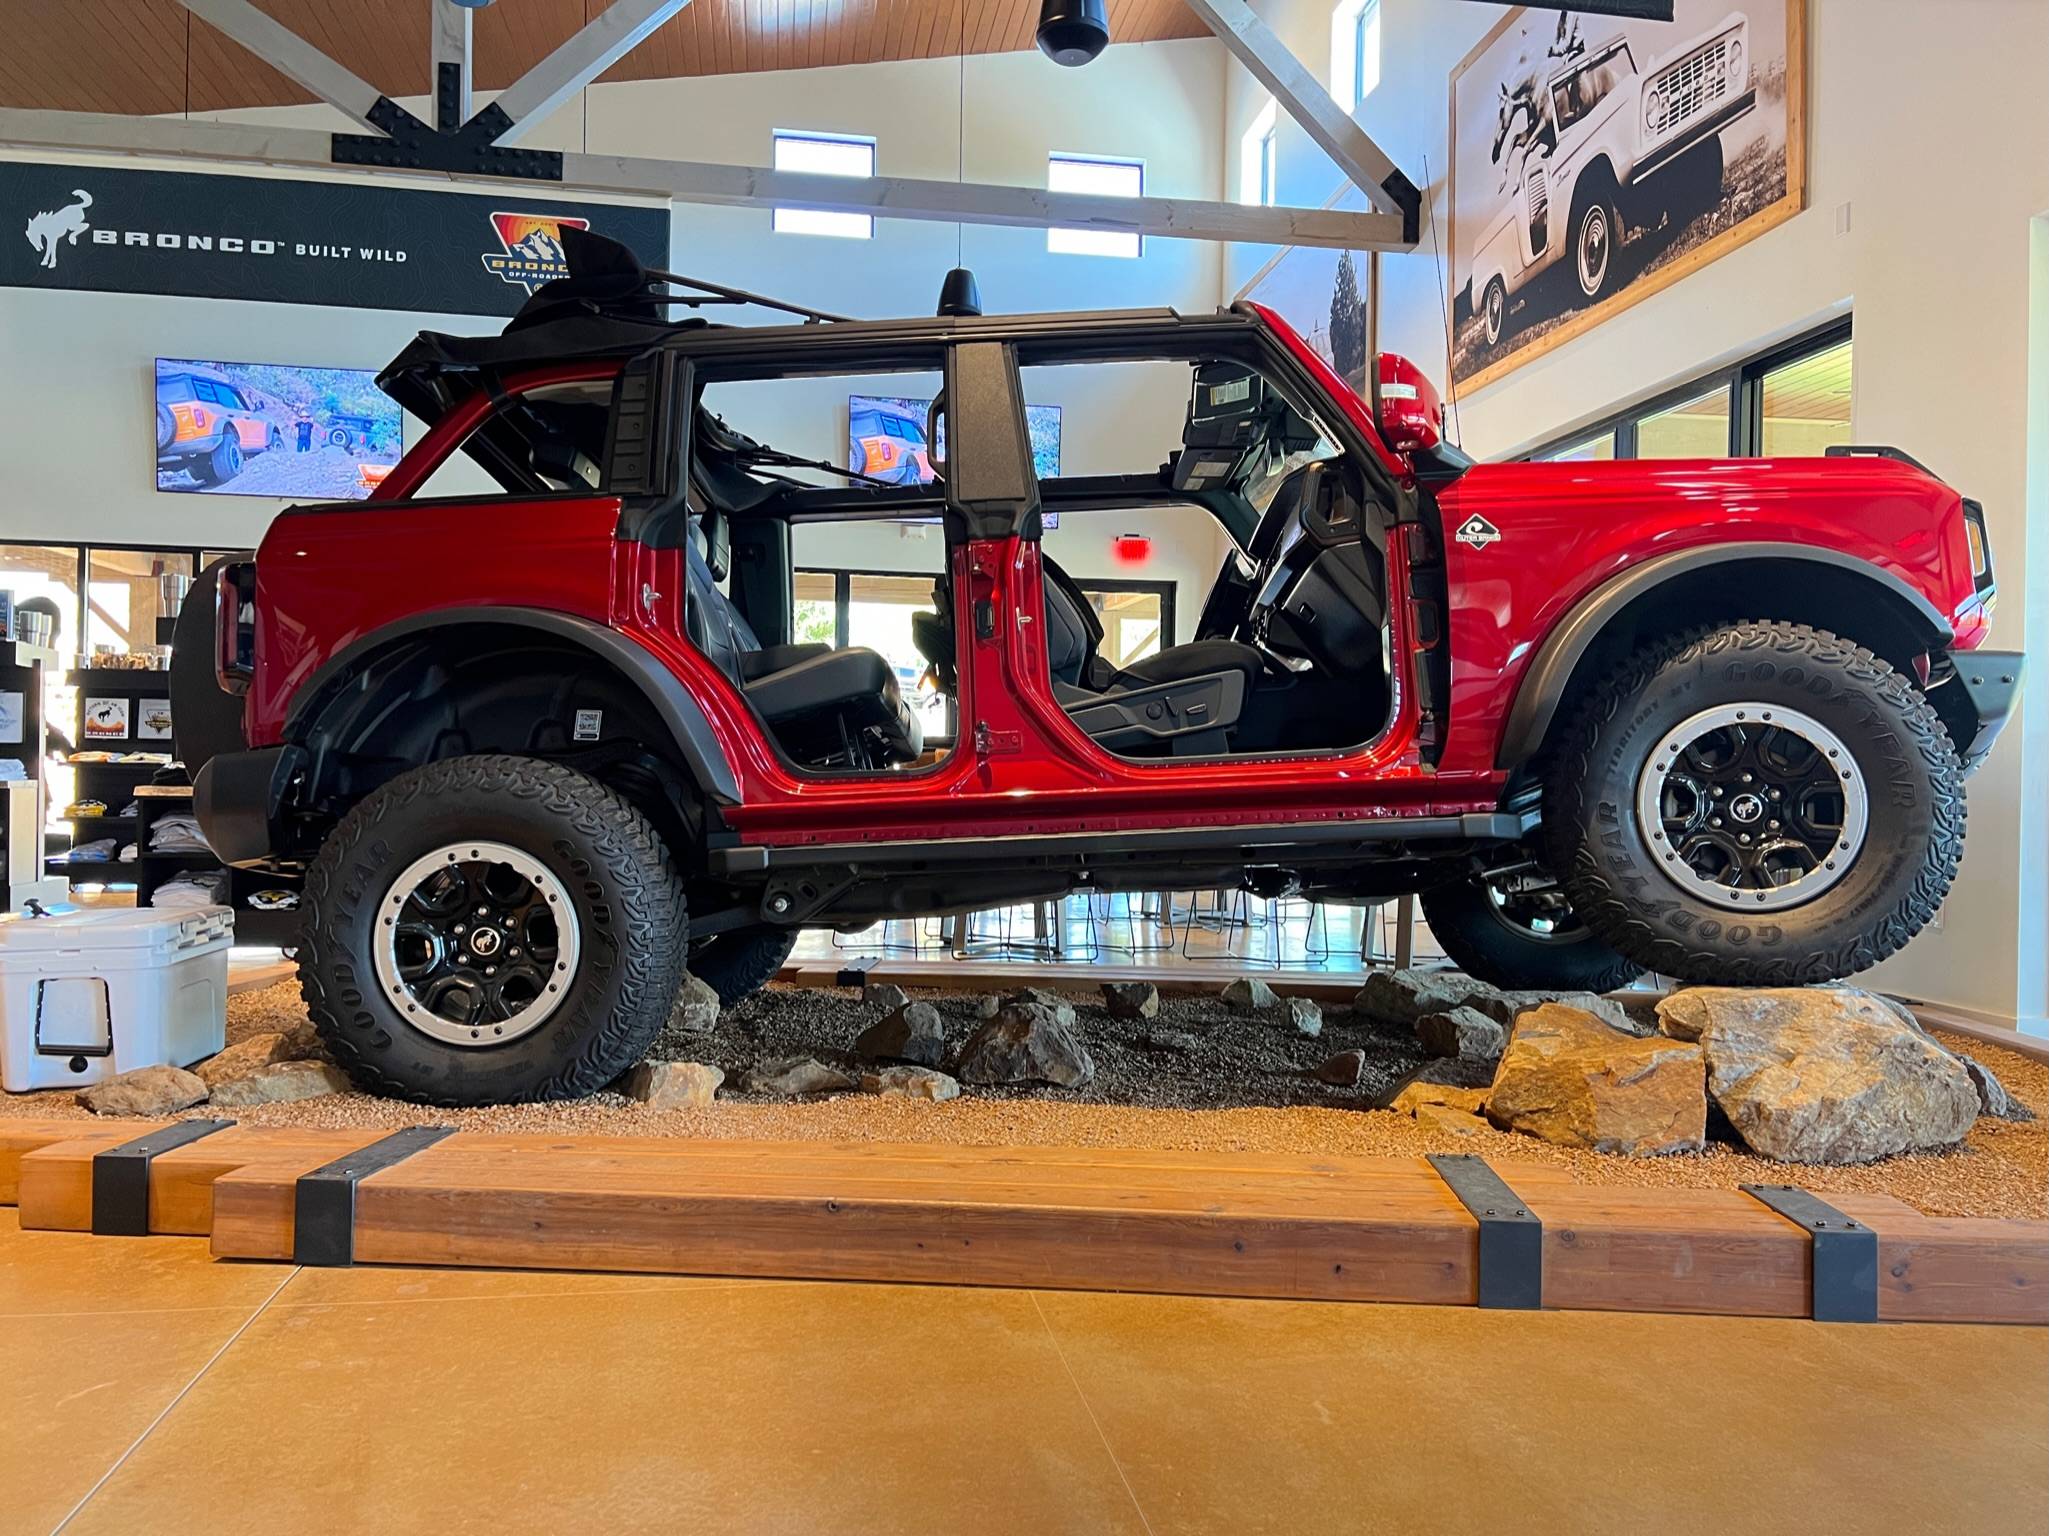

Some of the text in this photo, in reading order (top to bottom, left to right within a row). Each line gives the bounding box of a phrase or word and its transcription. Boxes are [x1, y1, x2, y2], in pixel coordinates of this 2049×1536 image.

[295, 243, 351, 258] BUILT
[360, 247, 407, 263] WILD
[491, 260, 568, 272] BRONC
[1597, 801, 1783, 946] GOODYEAR
